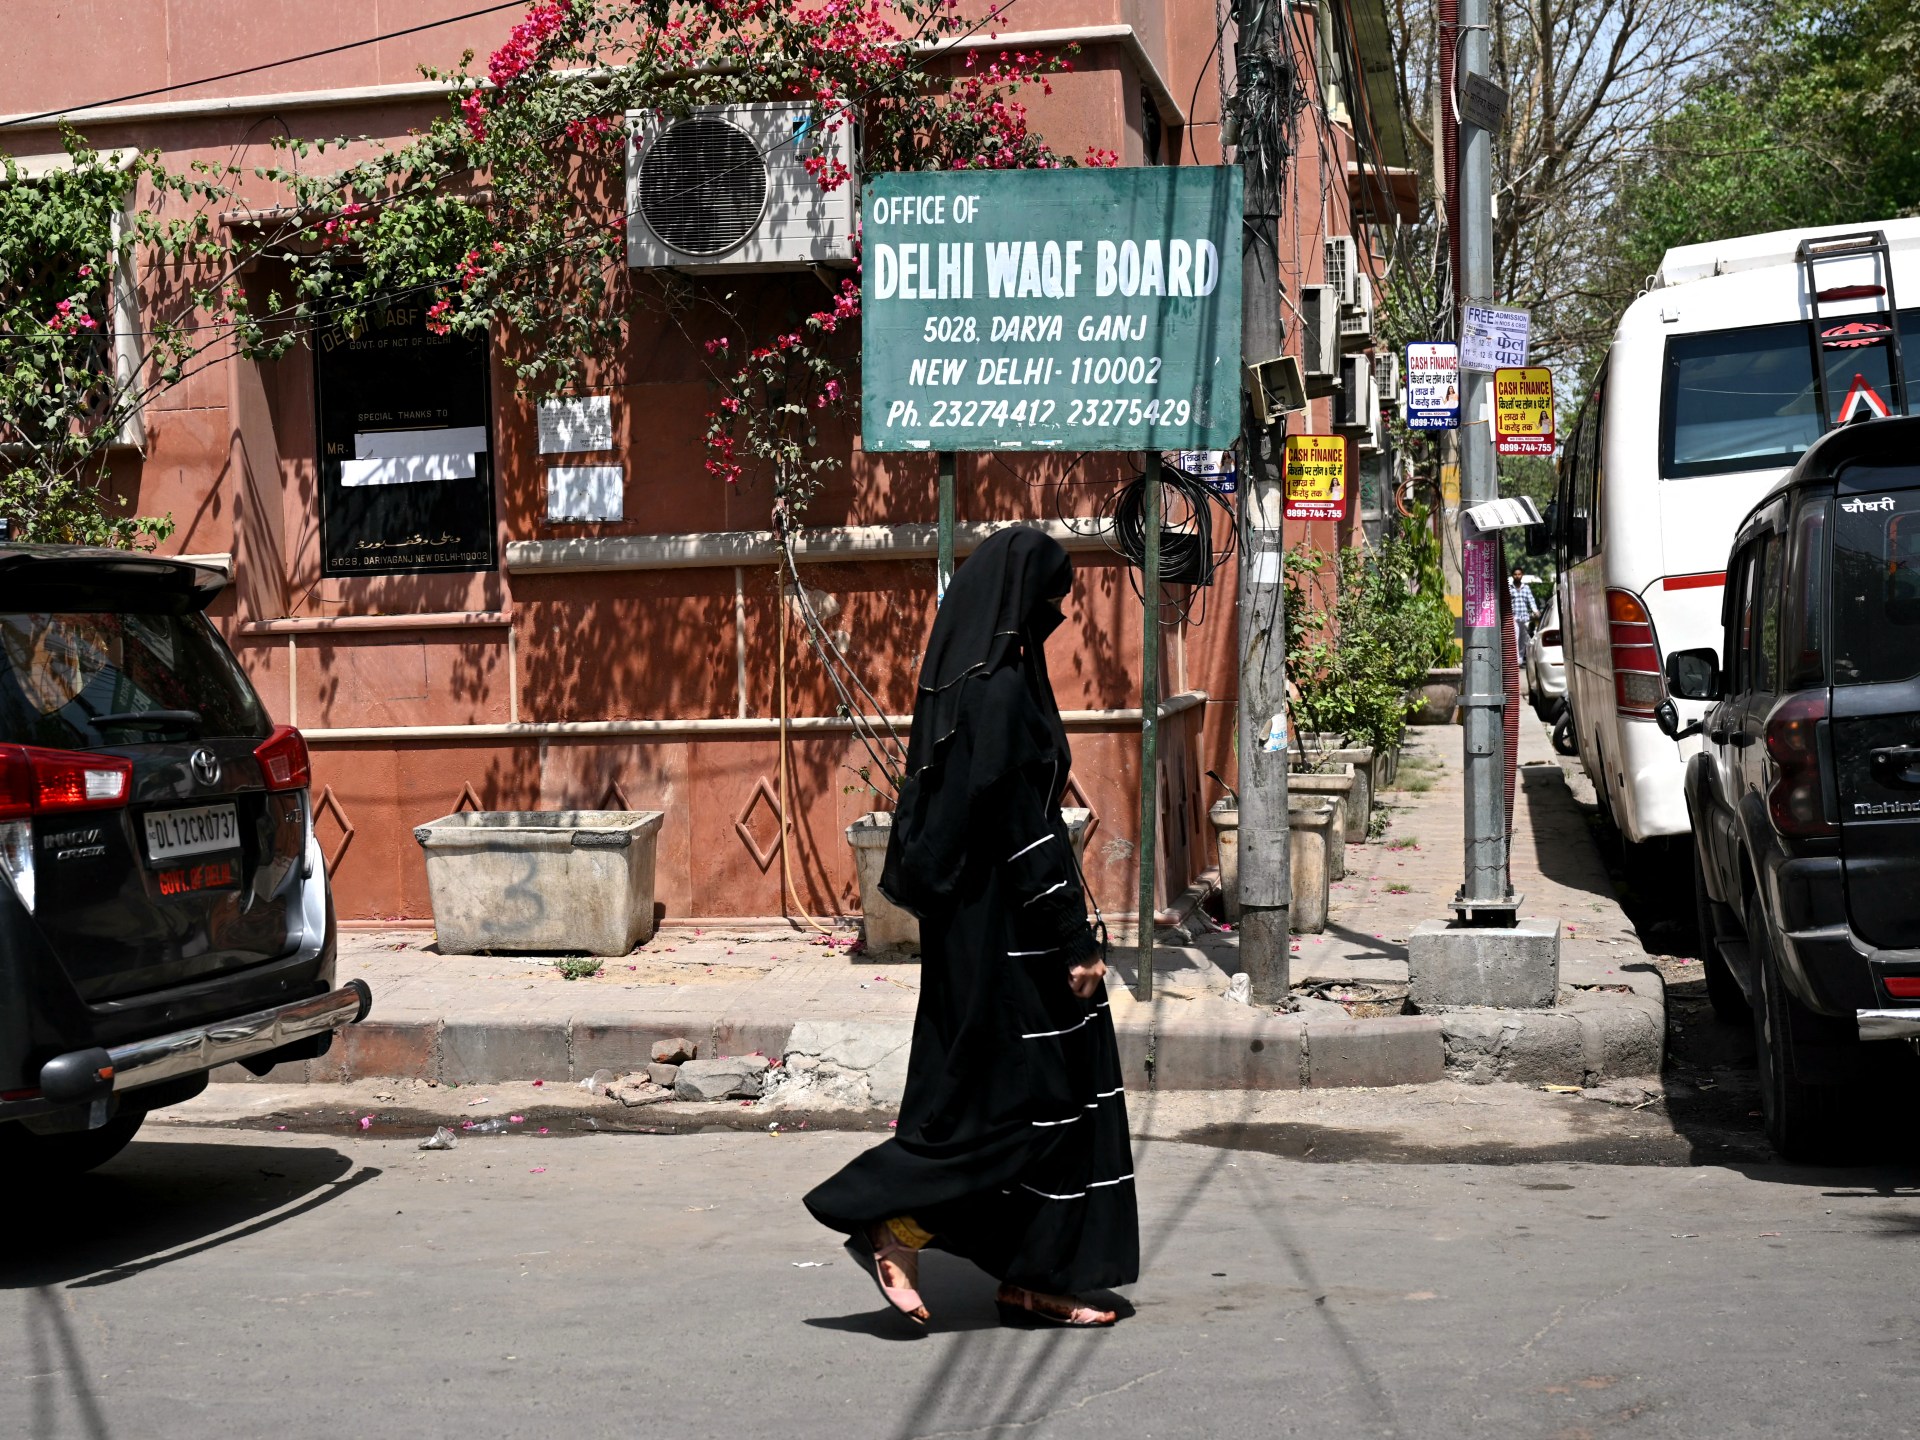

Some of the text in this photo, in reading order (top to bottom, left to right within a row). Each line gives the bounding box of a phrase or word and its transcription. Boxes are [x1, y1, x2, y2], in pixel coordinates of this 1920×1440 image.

[874, 195, 980, 224] OFFICE OF
[874, 239, 1219, 300] DELHI WAQF BOARD
[1468, 308, 1494, 324] FREE
[1495, 312, 1527, 322] ADMISSION
[990, 315, 1062, 342] DARYA
[1078, 315, 1148, 341] GANJ
[1497, 332, 1524, 351] फेल
[1410, 356, 1457, 370] CASH FINANCE
[1495, 350, 1524, 366] पास
[910, 358, 968, 386] NEW
[1071, 356, 1162, 384] 110002
[1499, 382, 1549, 395] CASH FINANCE
[358, 409, 448, 421] SPECIAL THANKS TO
[887, 400, 921, 428] Ph.
[1066, 398, 1190, 427] 23275429
[1410, 418, 1458, 426] 9899-744-755
[1288, 449, 1342, 462] CASH FINANCE
[1500, 444, 1552, 452] 9899-744-755
[1841, 497, 1896, 513] चौधरी
[1286, 509, 1342, 518] 9899-744-755
[332, 552, 487, 566] 5028, DARIYAGANJ NEW DELHI-110002
[159, 869, 190, 895] GOVT.
